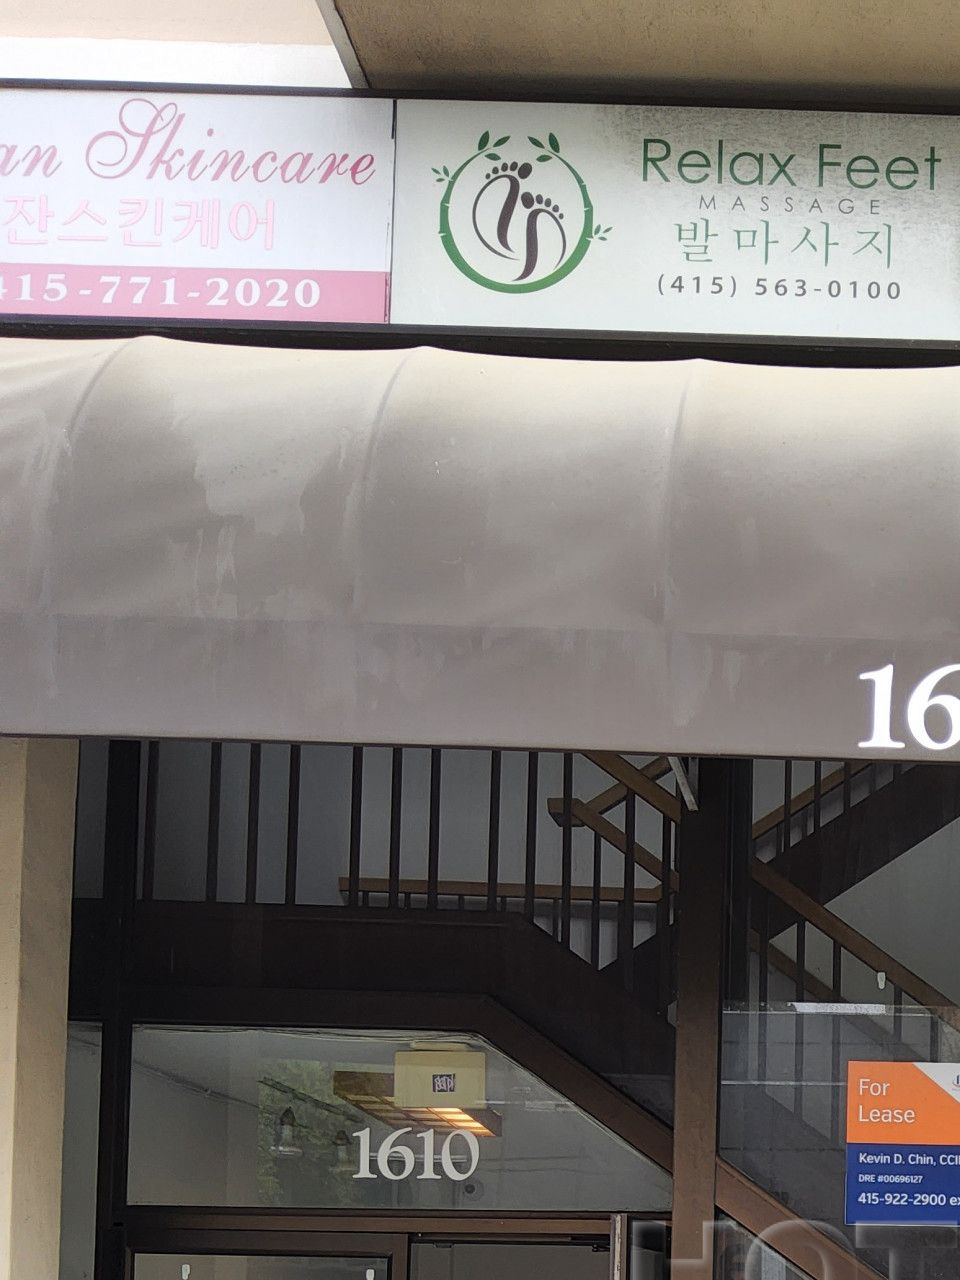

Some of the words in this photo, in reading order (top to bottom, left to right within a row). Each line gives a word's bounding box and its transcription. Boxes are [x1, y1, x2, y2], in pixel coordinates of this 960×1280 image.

[85, 98, 376, 186] Skincare
[641, 138, 797, 187] Relax
[817, 143, 942, 190] Feet
[699, 196, 882, 215] MASSAGE
[7, 194, 276, 251] 잔스킨케어
[0, 272, 321, 308] 15-771-2020
[658, 274, 738, 298] (415)
[754, 277, 902, 300] 563-0100
[859, 1078, 890, 1096] For
[859, 1105, 915, 1123] Lease
[352, 1127, 480, 1181] 1610
[859, 1153, 890, 1164] Kevin
[894, 1153, 905, 1165] D.
[908, 1154, 937, 1166] Chin,
[858, 1174, 875, 1183] DRE
[858, 1192, 947, 1206] 415-922-2900
